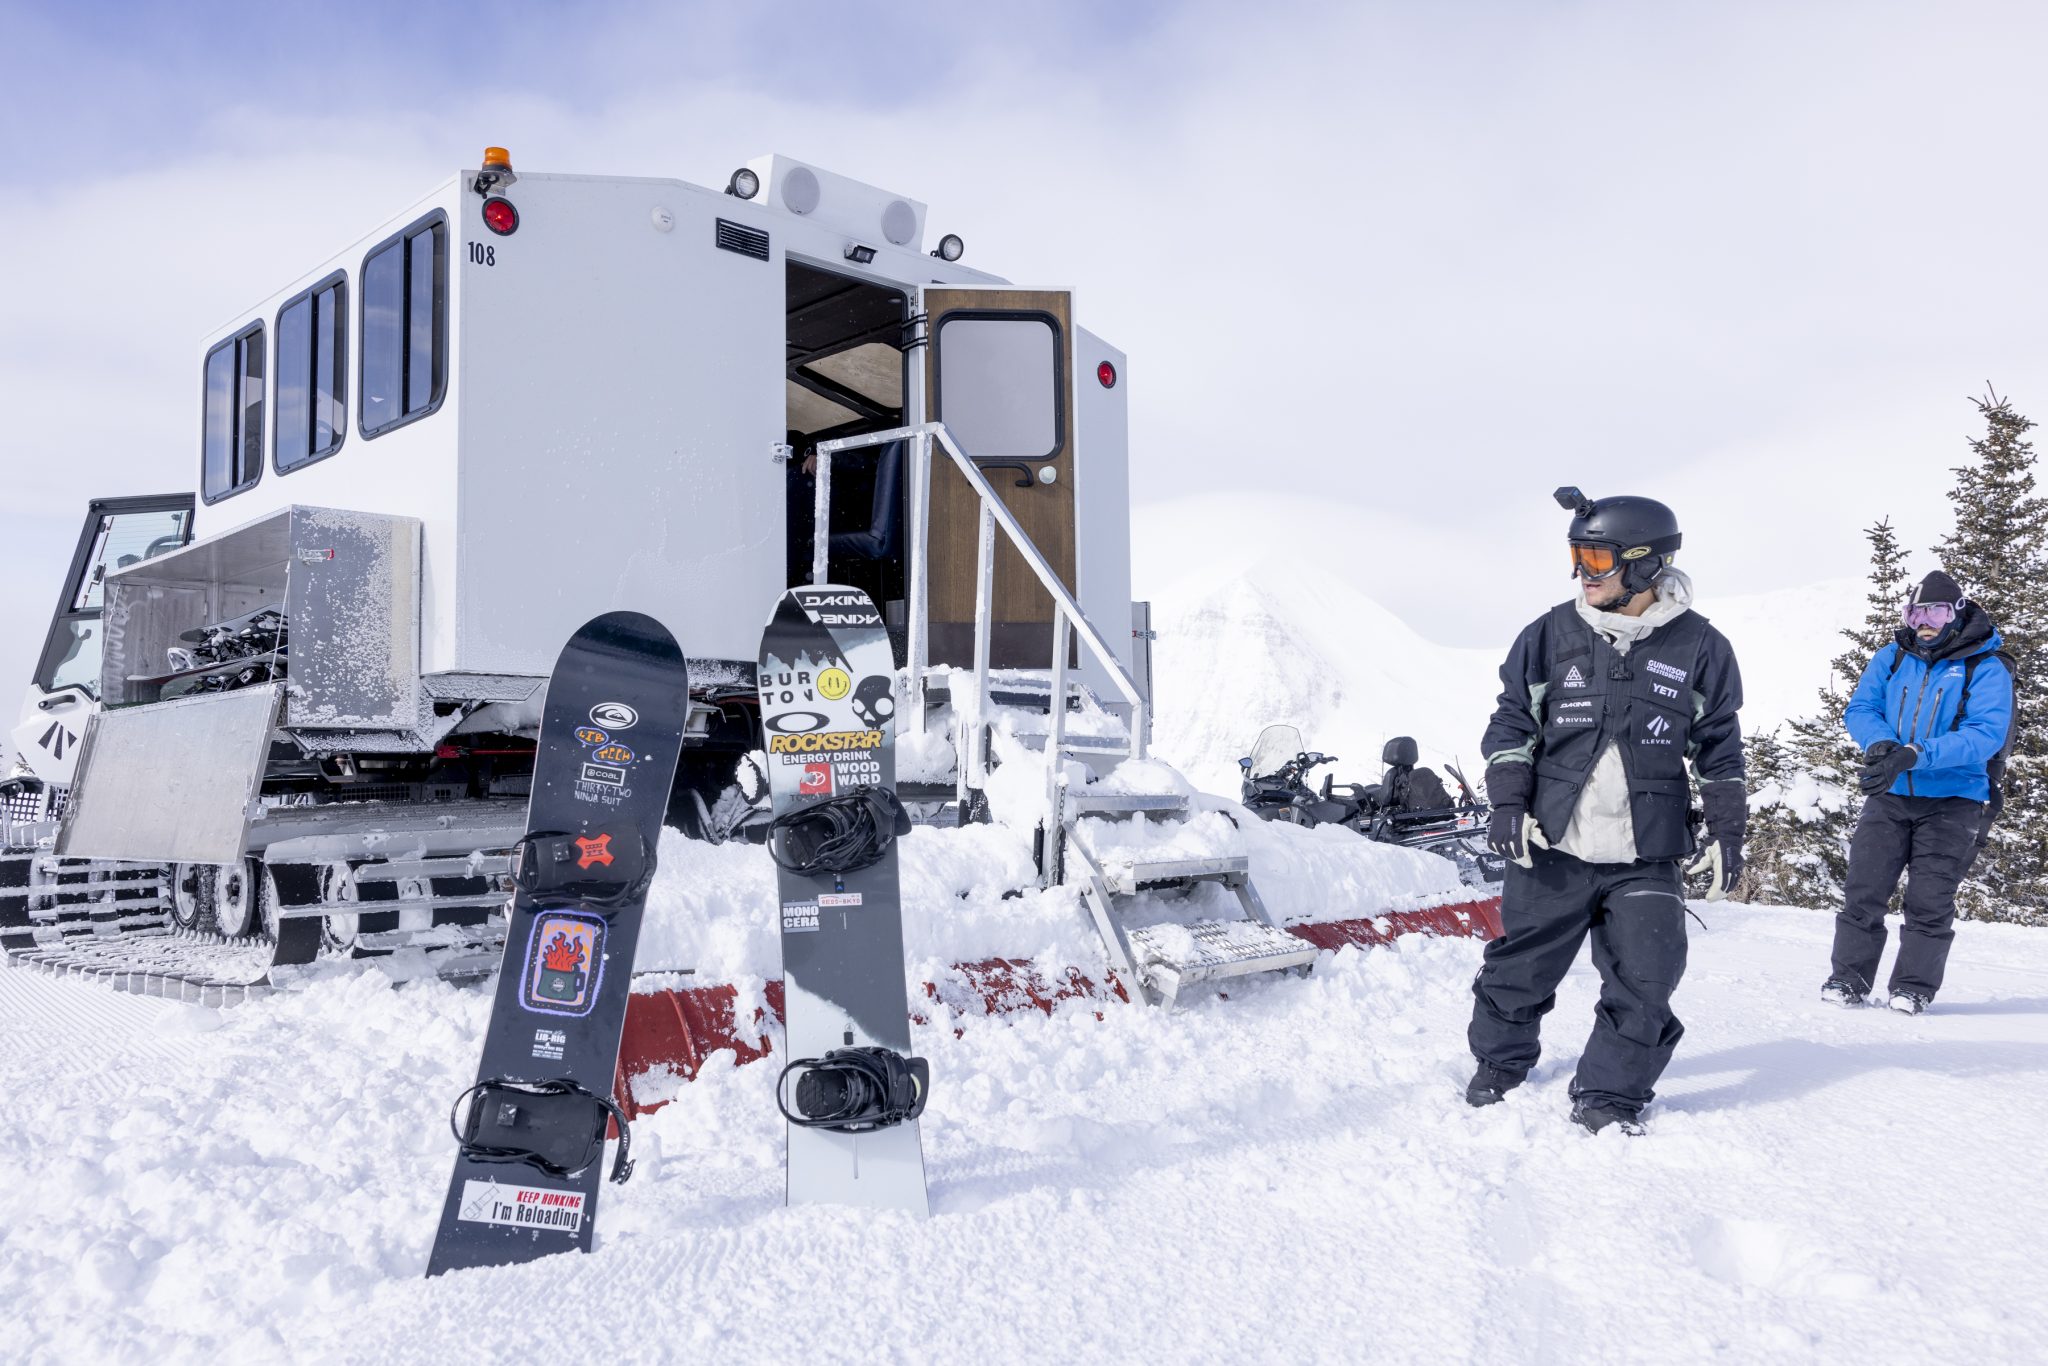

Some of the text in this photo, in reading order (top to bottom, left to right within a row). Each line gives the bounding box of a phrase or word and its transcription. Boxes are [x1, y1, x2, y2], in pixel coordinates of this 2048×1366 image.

[467, 241, 496, 267] 108
[804, 596, 874, 606] DAKINE
[821, 614, 885, 624] AKINE
[1647, 659, 1688, 678] GUNNISON
[760, 671, 811, 688] BUR
[762, 688, 814, 705] TON
[1653, 682, 1679, 699] YETI
[579, 730, 605, 743] LIB
[770, 731, 882, 753] ROCKSTAR
[598, 746, 631, 761] TECH
[782, 751, 872, 765] ENERGY DRINK
[836, 762, 881, 774] WOOD
[837, 773, 881, 786] WARD
[574, 780, 632, 798] THIRTY-TWO
[574, 791, 622, 806] NINJA SUIT
[783, 906, 819, 917] MONO
[783, 917, 819, 928] CERA
[516, 1190, 582, 1208] KEEP HONKING
[492, 1201, 580, 1230] I'm Reloading
